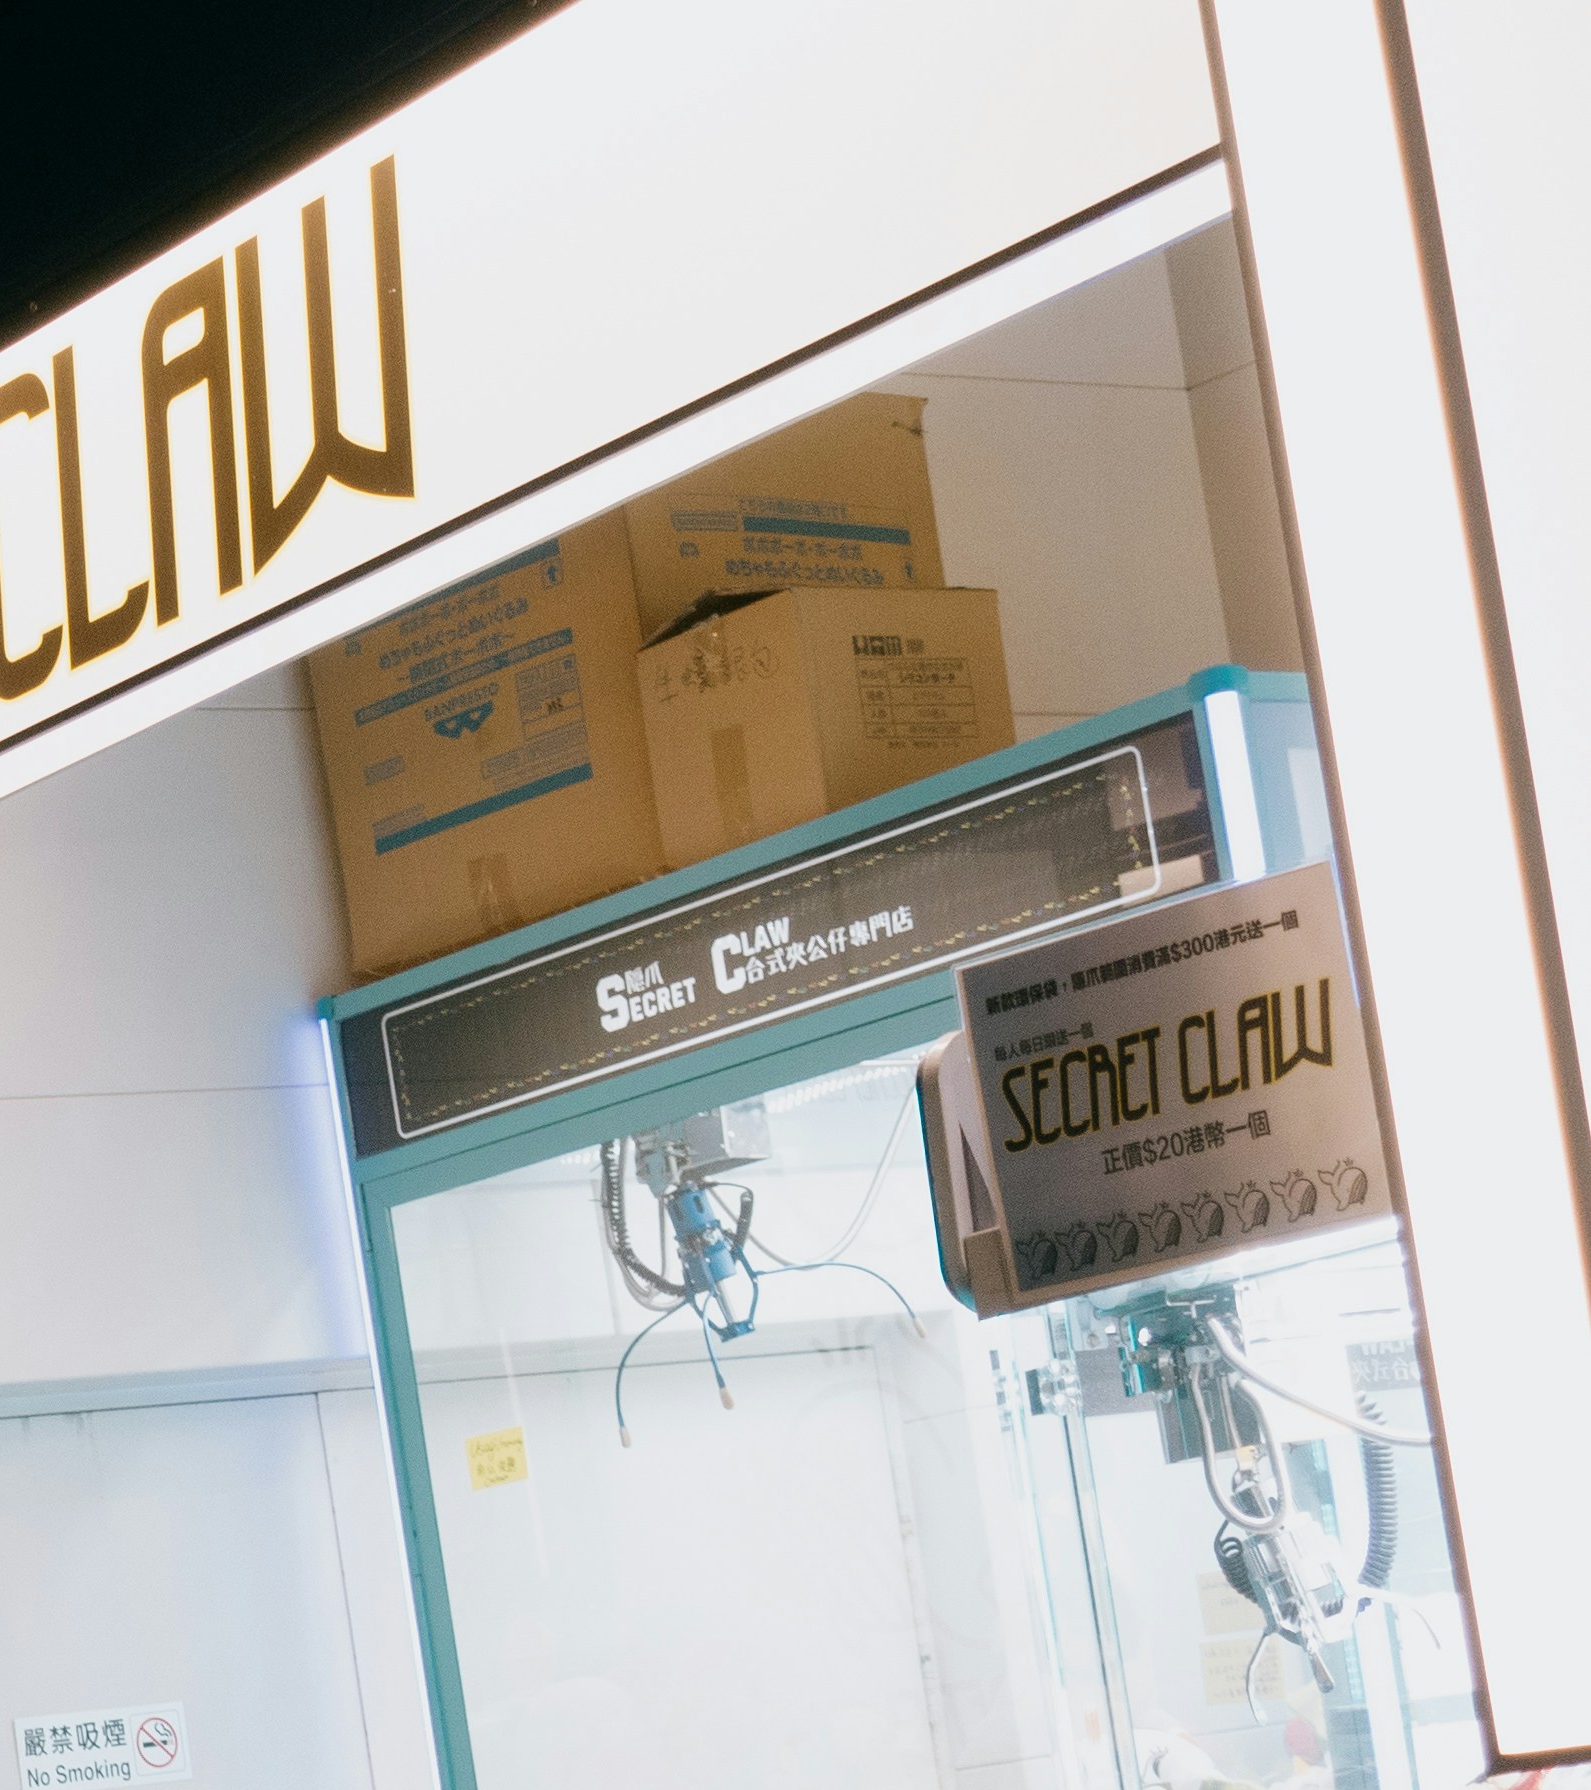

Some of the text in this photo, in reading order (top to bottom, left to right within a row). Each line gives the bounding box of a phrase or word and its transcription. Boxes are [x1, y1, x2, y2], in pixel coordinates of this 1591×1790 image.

[596, 917, 789, 1032] SECRET CLAW
[1002, 977, 1333, 1153] SECRET CLAW
[1101, 1110, 1271, 1176] 正價$20港幣一個
[23, 1718, 127, 1757] 嚴禁吸煙
[27, 1759, 131, 1788] No Smoking
